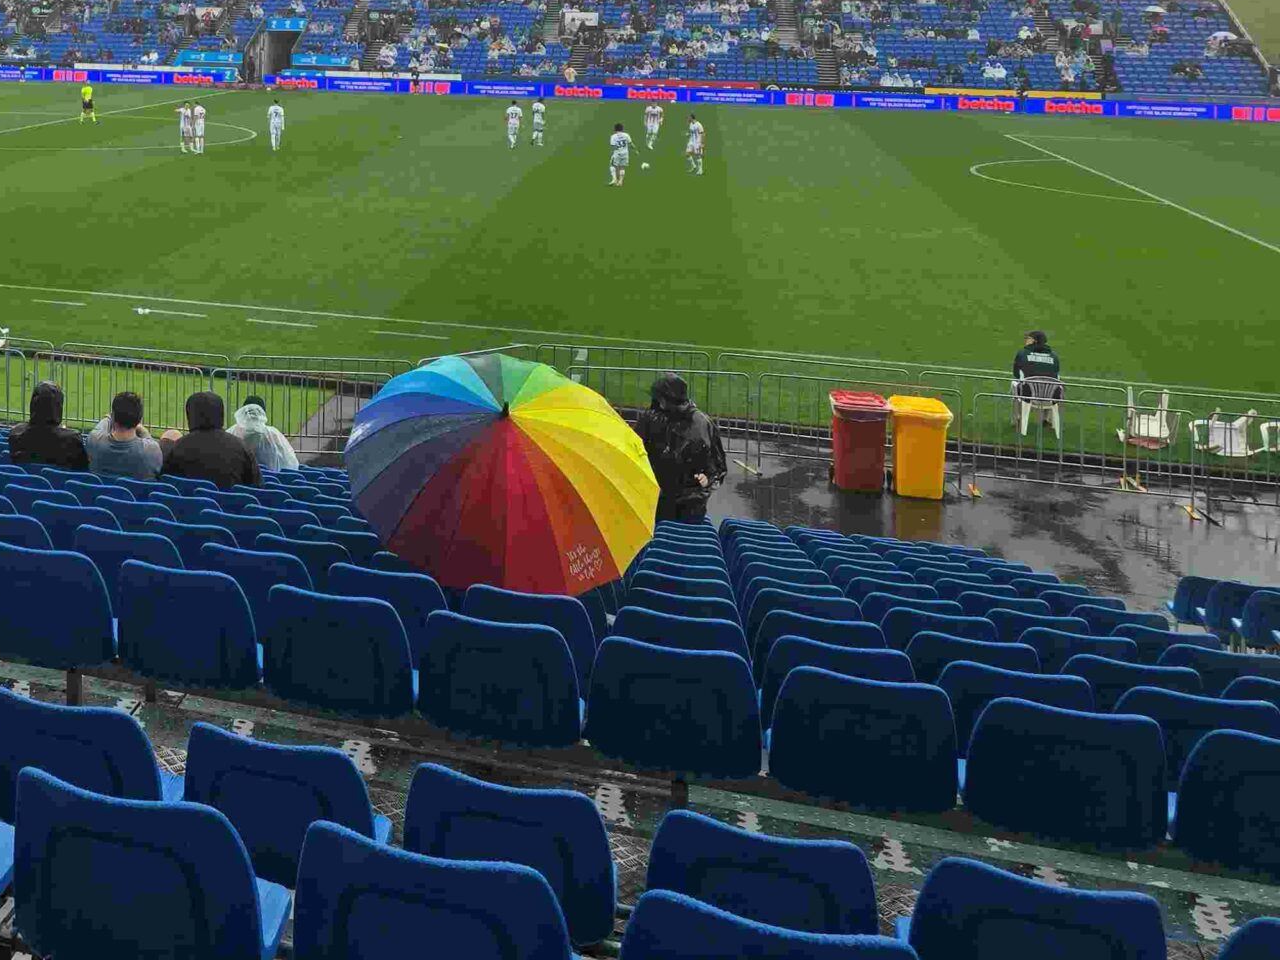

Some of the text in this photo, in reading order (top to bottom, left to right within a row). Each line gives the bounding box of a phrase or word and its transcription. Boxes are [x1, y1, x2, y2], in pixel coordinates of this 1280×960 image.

[276, 77, 317, 88] betcha
[554, 85, 602, 97] betcha
[627, 88, 677, 100] betcha
[958, 97, 1014, 110] betcha
[1044, 100, 1103, 114] betcha
